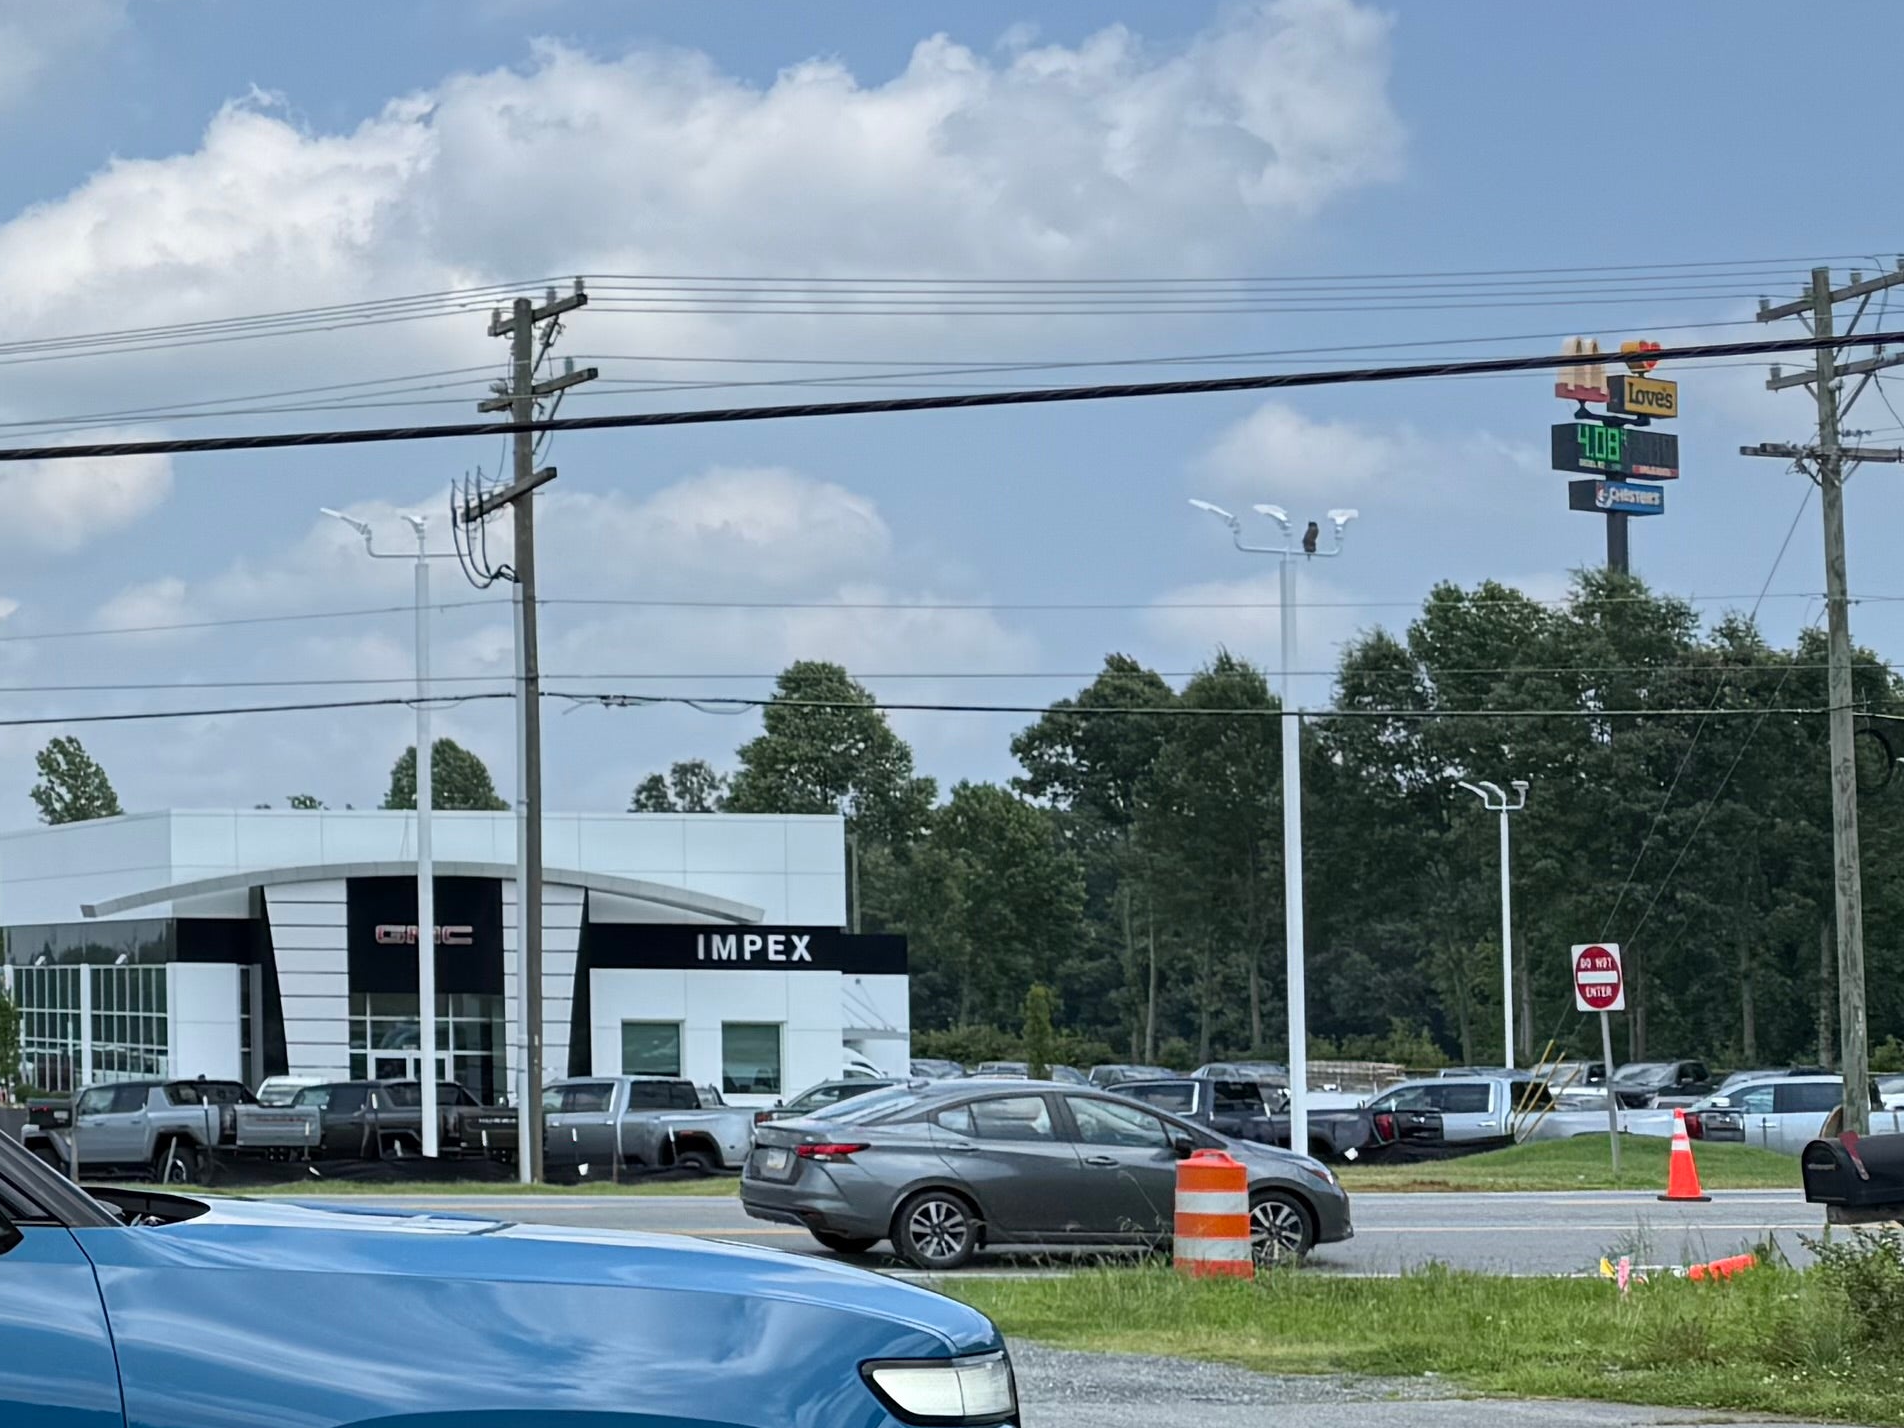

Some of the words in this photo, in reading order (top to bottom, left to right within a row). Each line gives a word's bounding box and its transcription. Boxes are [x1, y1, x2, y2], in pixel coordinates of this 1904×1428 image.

[1627, 381, 1674, 409] Love's
[697, 933, 812, 962] IMPEX
[1580, 957, 1591, 969] DO
[1585, 985, 1613, 998] ENTER
